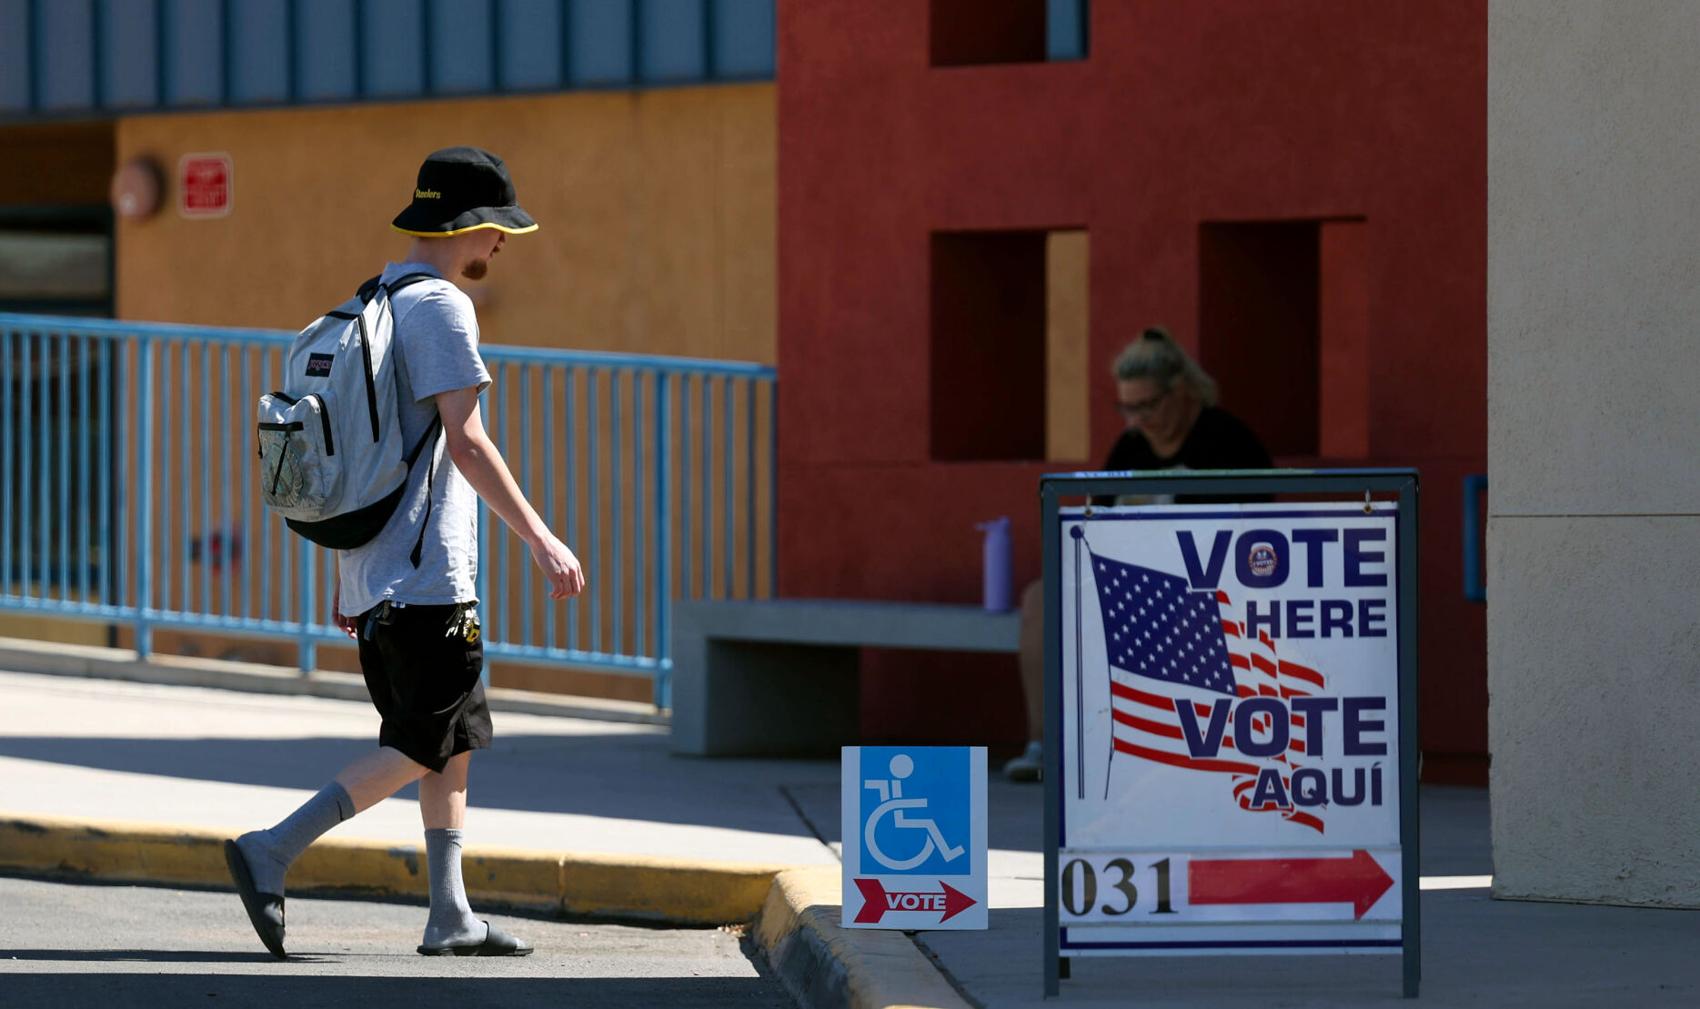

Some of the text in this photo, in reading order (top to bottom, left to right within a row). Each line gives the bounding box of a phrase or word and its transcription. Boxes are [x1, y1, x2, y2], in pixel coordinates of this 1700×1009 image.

[1176, 528, 1388, 588] VOTE
[1247, 600, 1387, 638] HERE
[1175, 697, 1388, 757] VOTE
[1251, 762, 1383, 807] AQUÍ
[885, 894, 946, 909] VOTE
[1061, 857, 1179, 916] 031
